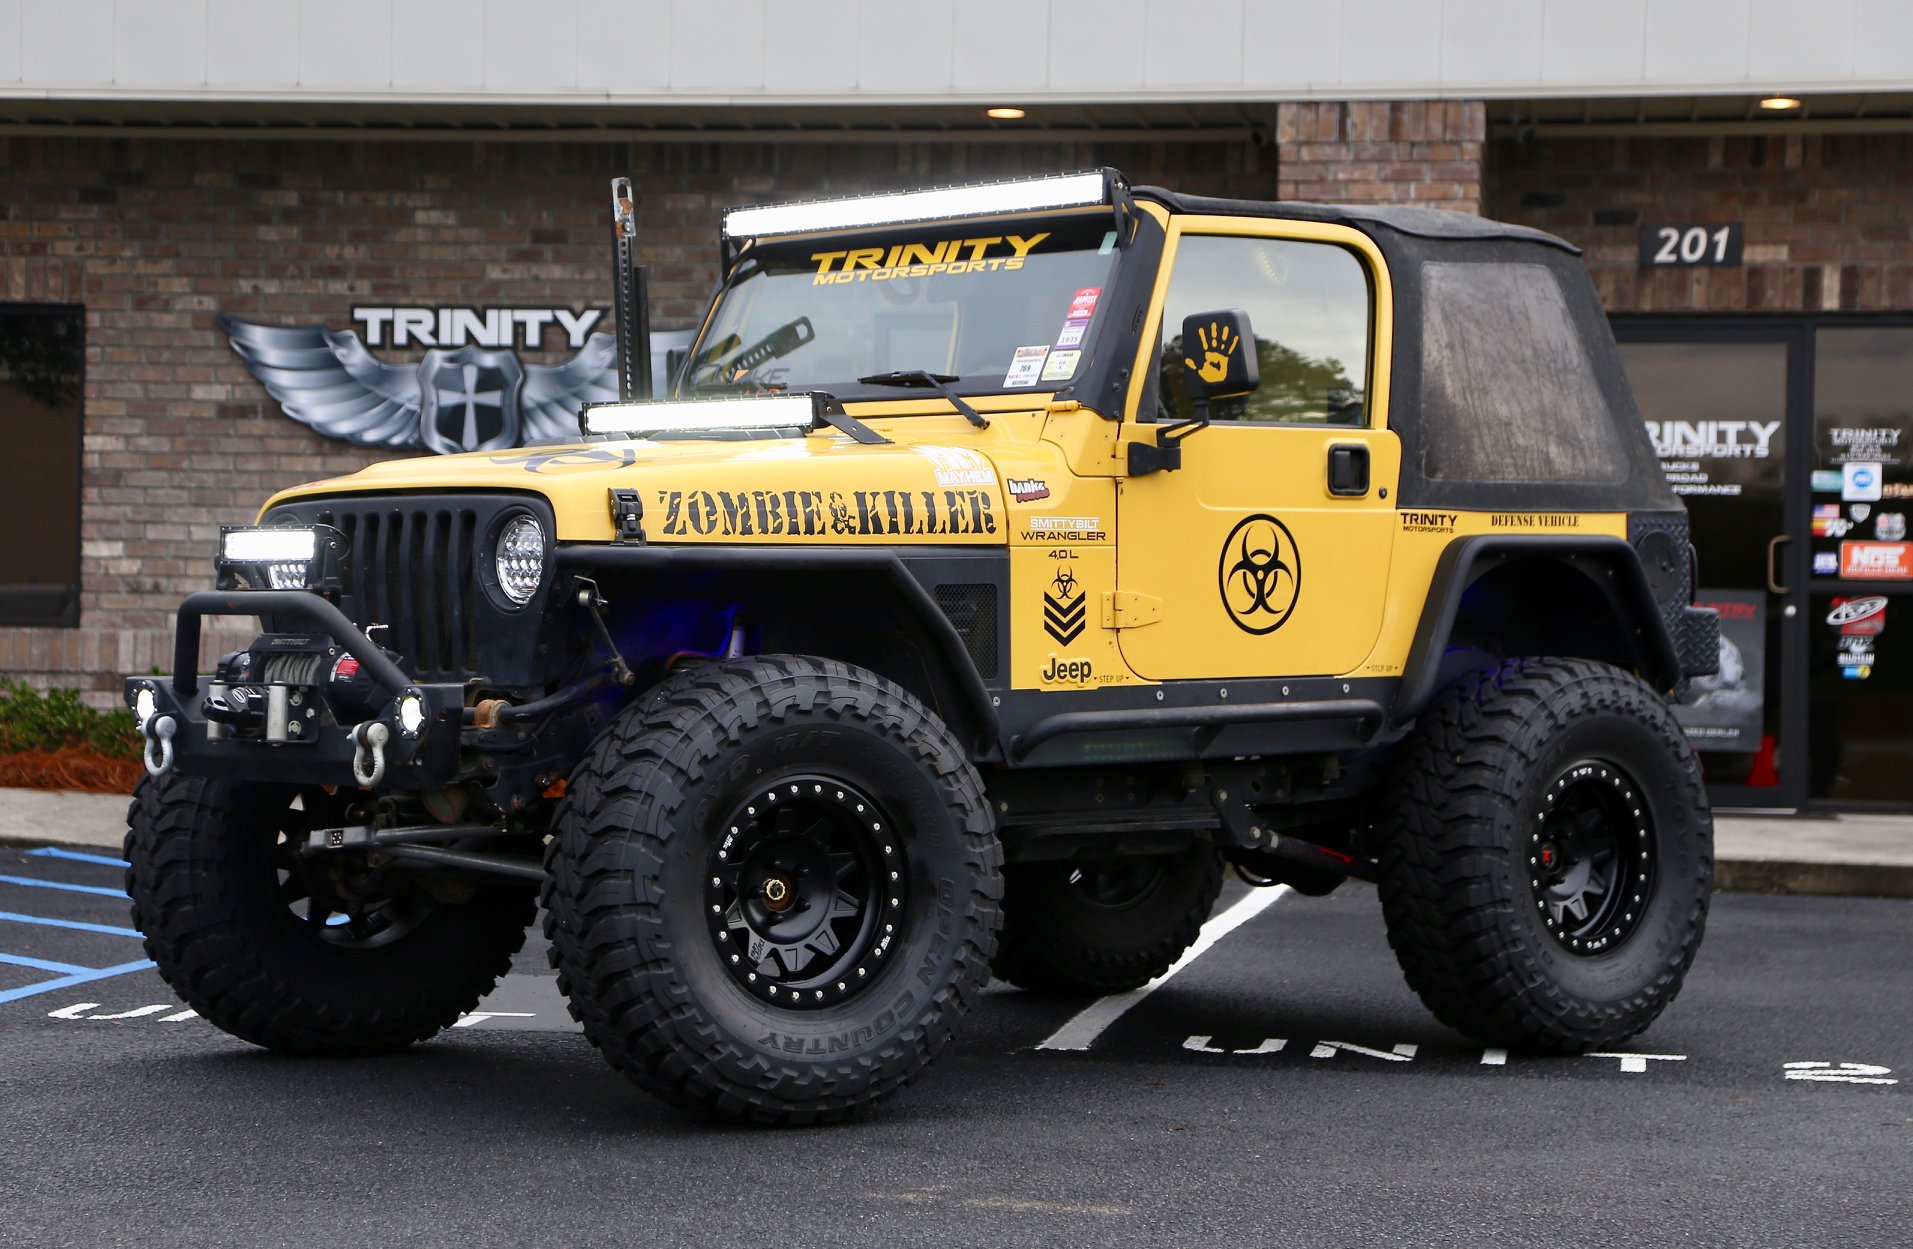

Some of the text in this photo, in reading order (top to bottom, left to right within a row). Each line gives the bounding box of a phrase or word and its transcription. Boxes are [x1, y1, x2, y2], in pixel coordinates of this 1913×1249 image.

[1653, 225, 1731, 264] 201
[810, 231, 1052, 275] TRINITY
[811, 256, 1026, 286] MOTORSPORTS
[352, 307, 602, 348] TRINITY
[1644, 420, 1782, 449] RINITY
[1829, 427, 1902, 442] TRINITY
[1655, 443, 1770, 458] ORSPORTS
[937, 470, 995, 485] MAYHEM
[1671, 484, 1742, 495] FORMANCE
[659, 490, 826, 536] ZOMBIE
[853, 490, 998, 536] KILLER
[1400, 513, 1458, 526] TRINITY
[1030, 518, 1100, 530] SMITTYBILT
[1491, 515, 1580, 528] DEFENSE VEHICLE
[1020, 531, 1107, 541] WRANGLER
[1403, 525, 1455, 534] MOTORSPORTS
[1042, 656, 1092, 684] Jeep
[1098, 674, 1125, 684] STEP UP
[758, 877, 956, 1055] OPEN COUNTRY
